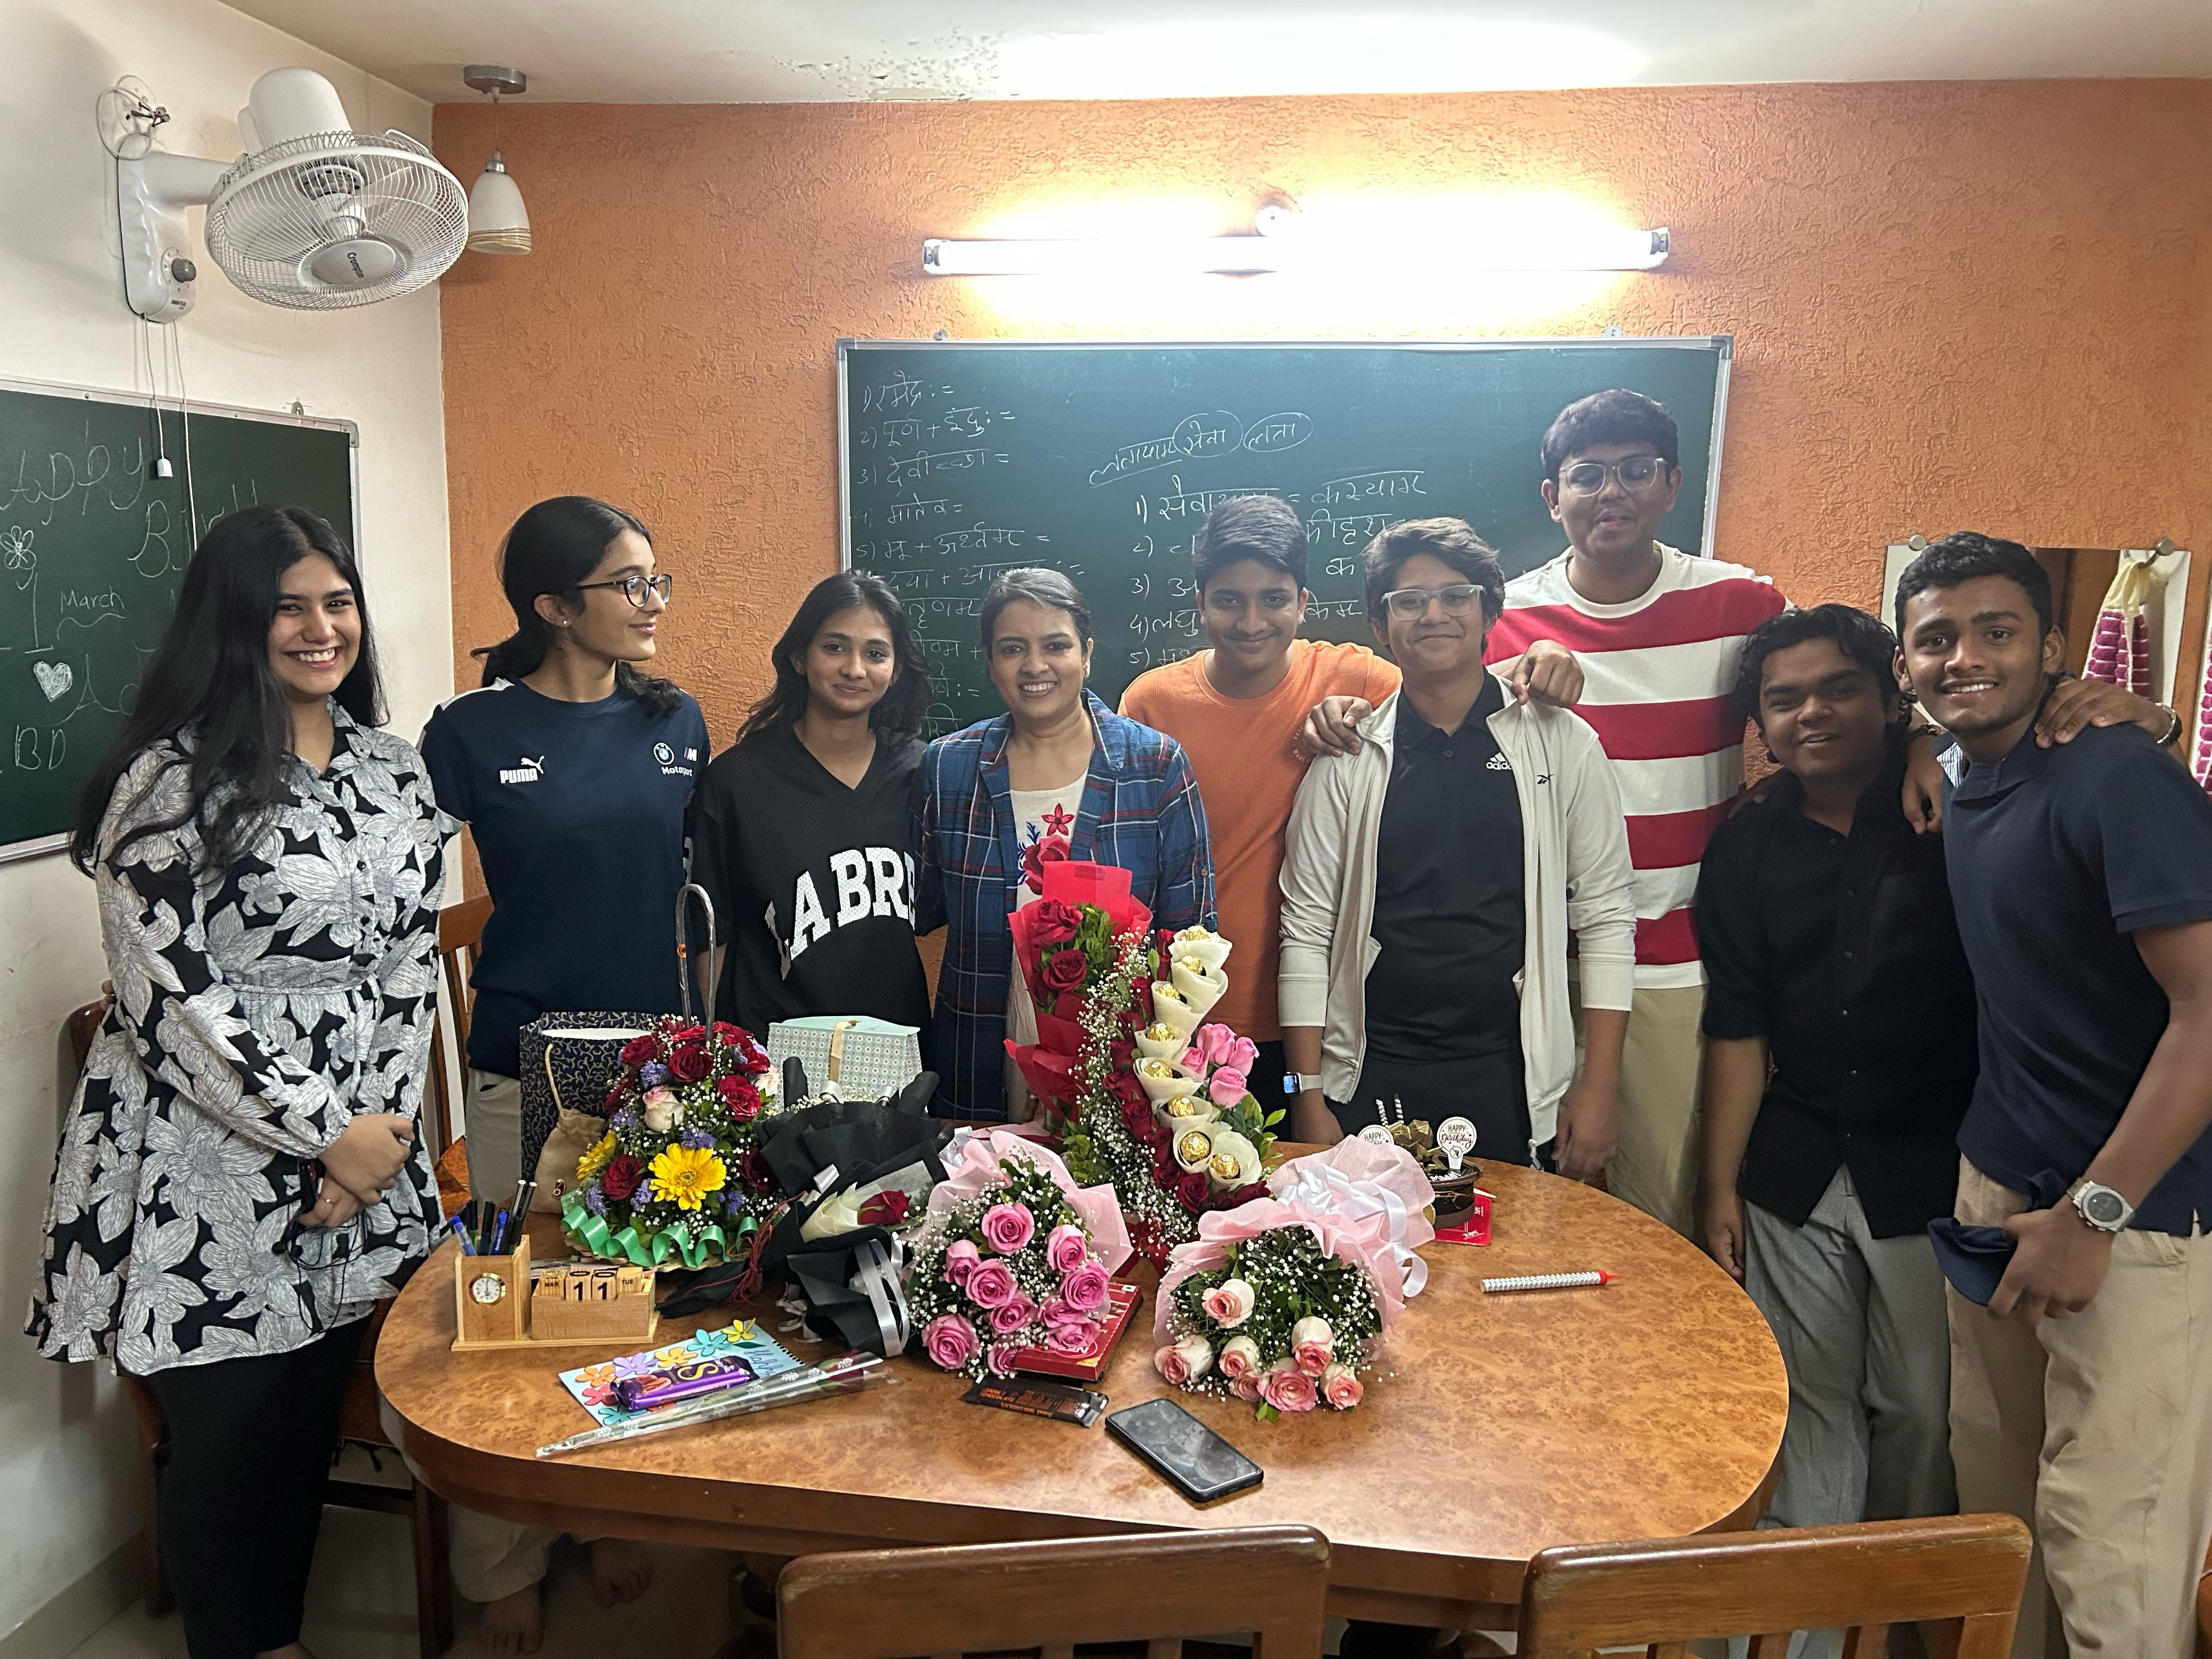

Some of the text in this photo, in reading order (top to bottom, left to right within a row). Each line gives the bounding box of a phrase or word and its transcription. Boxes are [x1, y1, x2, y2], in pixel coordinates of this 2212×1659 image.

[347, 252, 365, 279] Crompton
[60, 585, 125, 613] March
[499, 768, 538, 784] PUMA
[1364, 1132, 1381, 1142] HAPPY
[1448, 1124, 1466, 1132] HAPPY
[1441, 1132, 1474, 1150] Birthday
[573, 1281, 584, 1301] 1
[597, 1282, 608, 1300] 1
